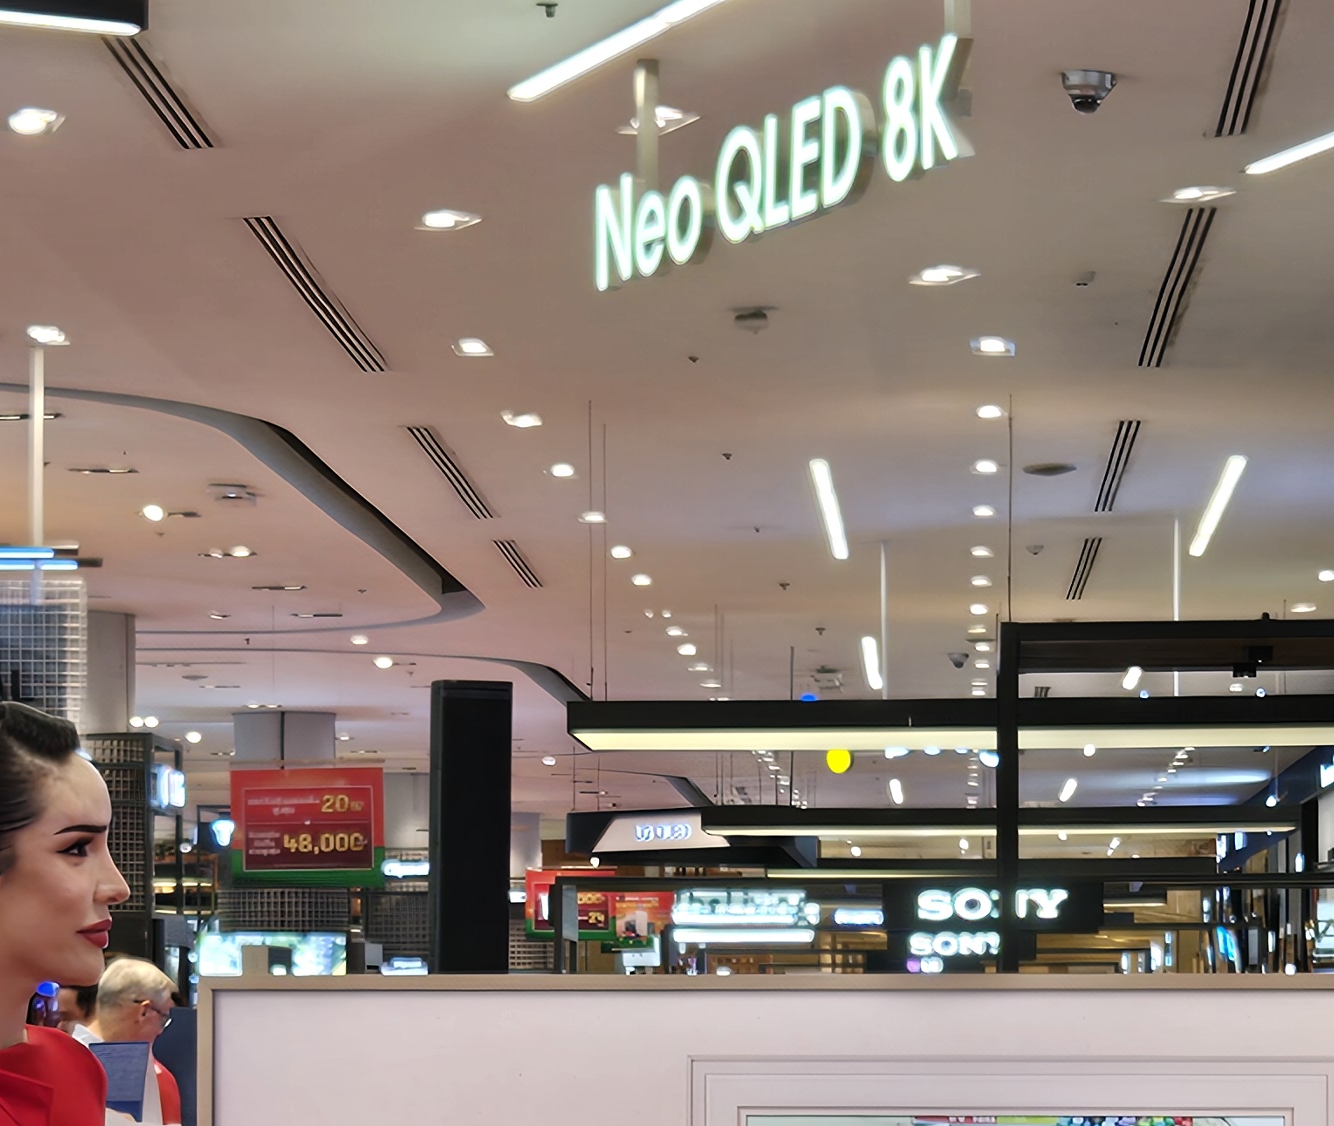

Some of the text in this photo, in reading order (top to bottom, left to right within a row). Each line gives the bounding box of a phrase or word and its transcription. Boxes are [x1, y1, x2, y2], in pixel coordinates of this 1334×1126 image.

[595, 33, 958, 292] Neo QLED 8K
[321, 794, 349, 813] 20
